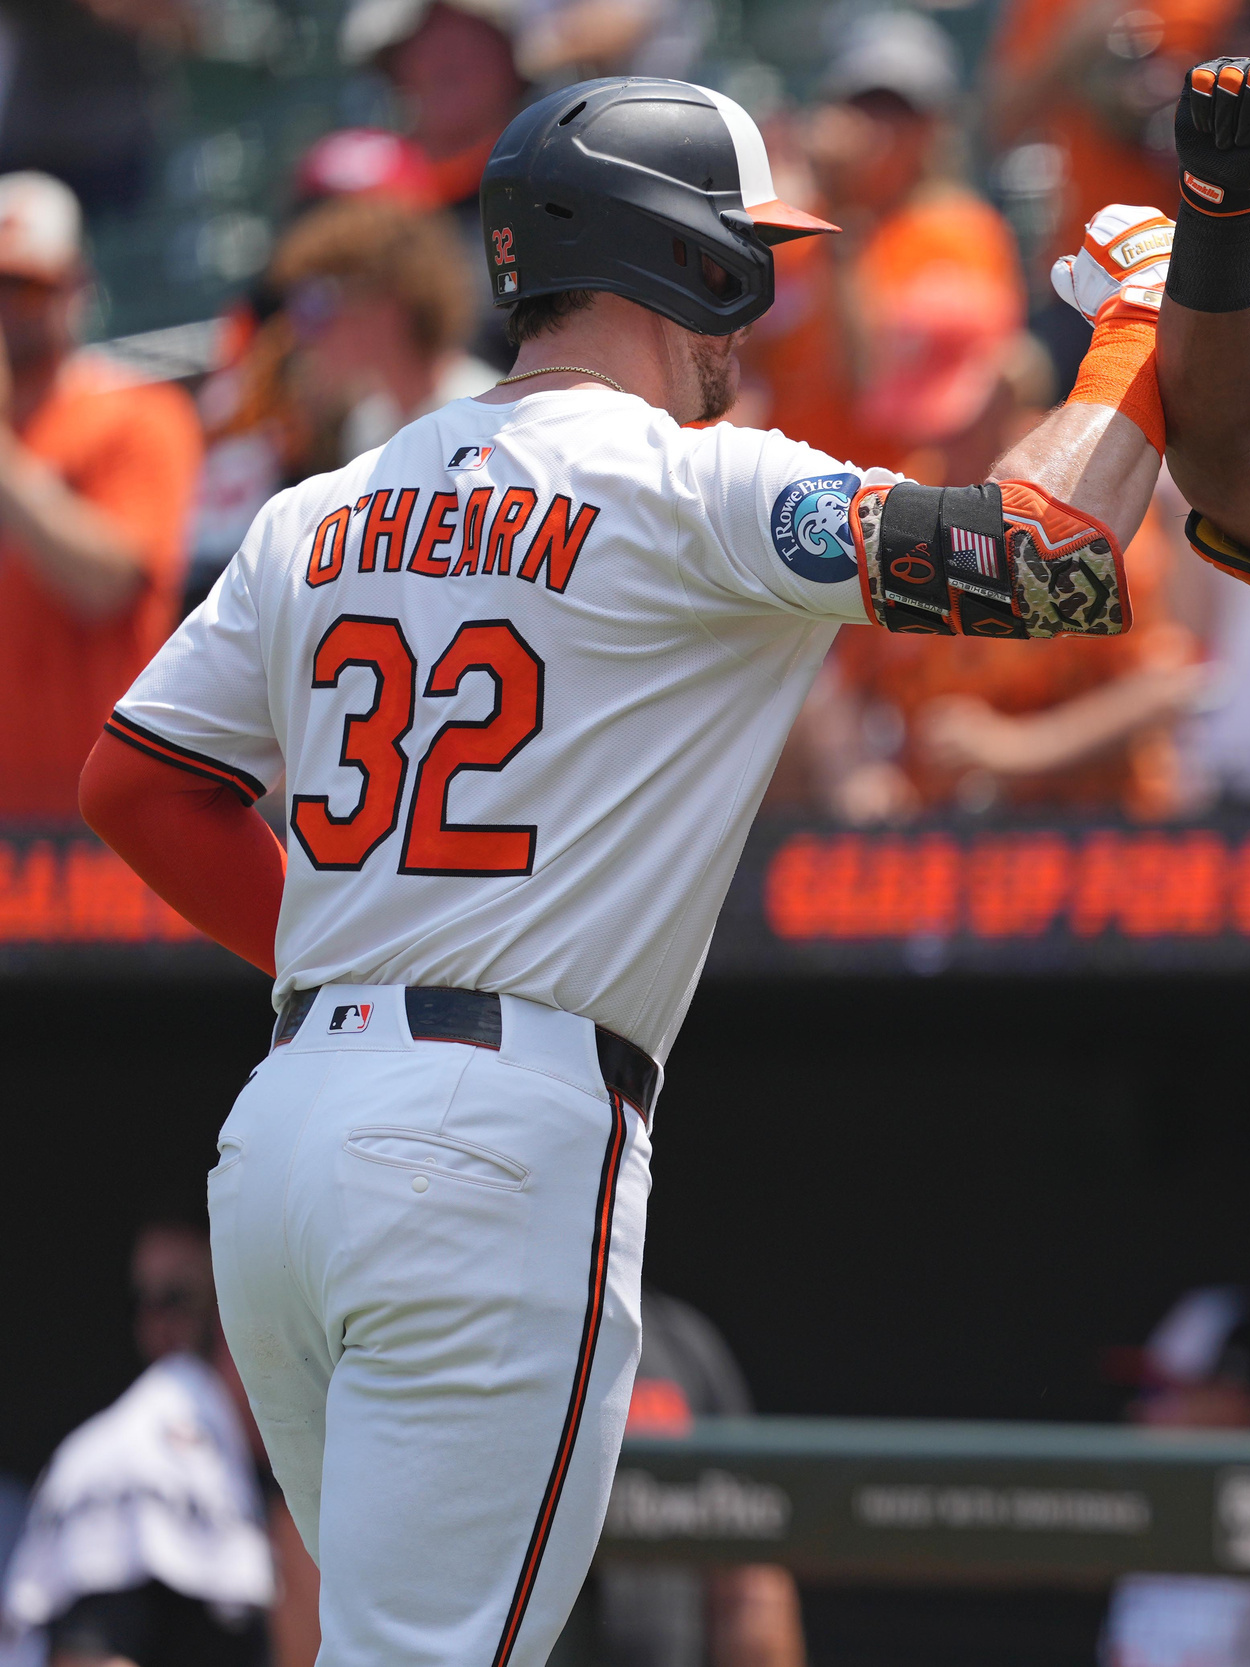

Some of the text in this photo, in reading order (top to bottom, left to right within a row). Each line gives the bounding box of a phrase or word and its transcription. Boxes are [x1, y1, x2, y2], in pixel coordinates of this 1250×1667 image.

[492, 226, 516, 266] 32
[305, 485, 601, 595] O'HEARN
[290, 613, 546, 878] 32
